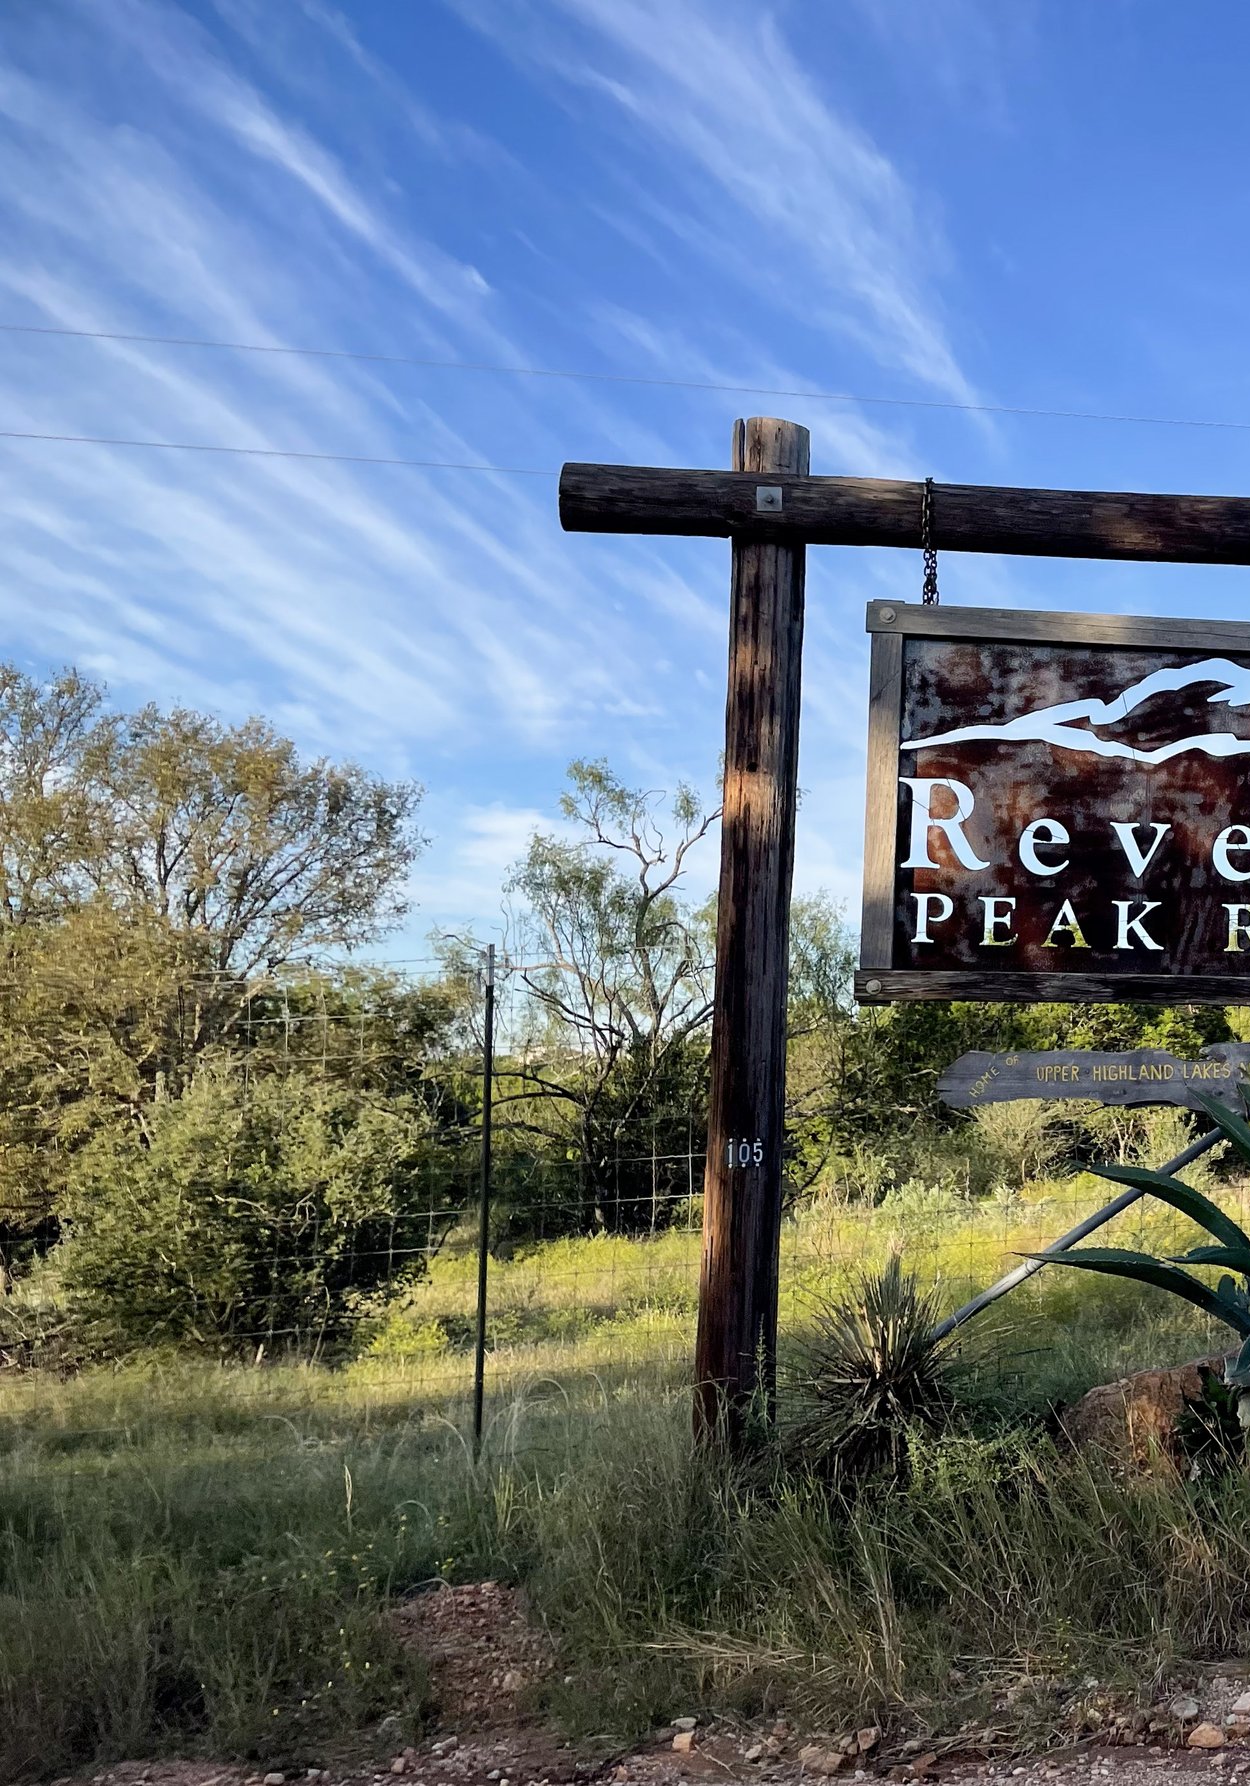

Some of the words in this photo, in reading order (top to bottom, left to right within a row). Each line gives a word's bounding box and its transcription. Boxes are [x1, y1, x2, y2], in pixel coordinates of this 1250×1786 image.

[910, 893, 1164, 951] PEAK
[969, 1065, 1000, 1098] HOME
[1005, 1055, 1019, 1067] OF
[1036, 1065, 1080, 1082] UPPER
[1092, 1064, 1174, 1081] HIGHLAND
[1183, 1062, 1231, 1079] LAKES
[727, 1141, 763, 1163] 105
